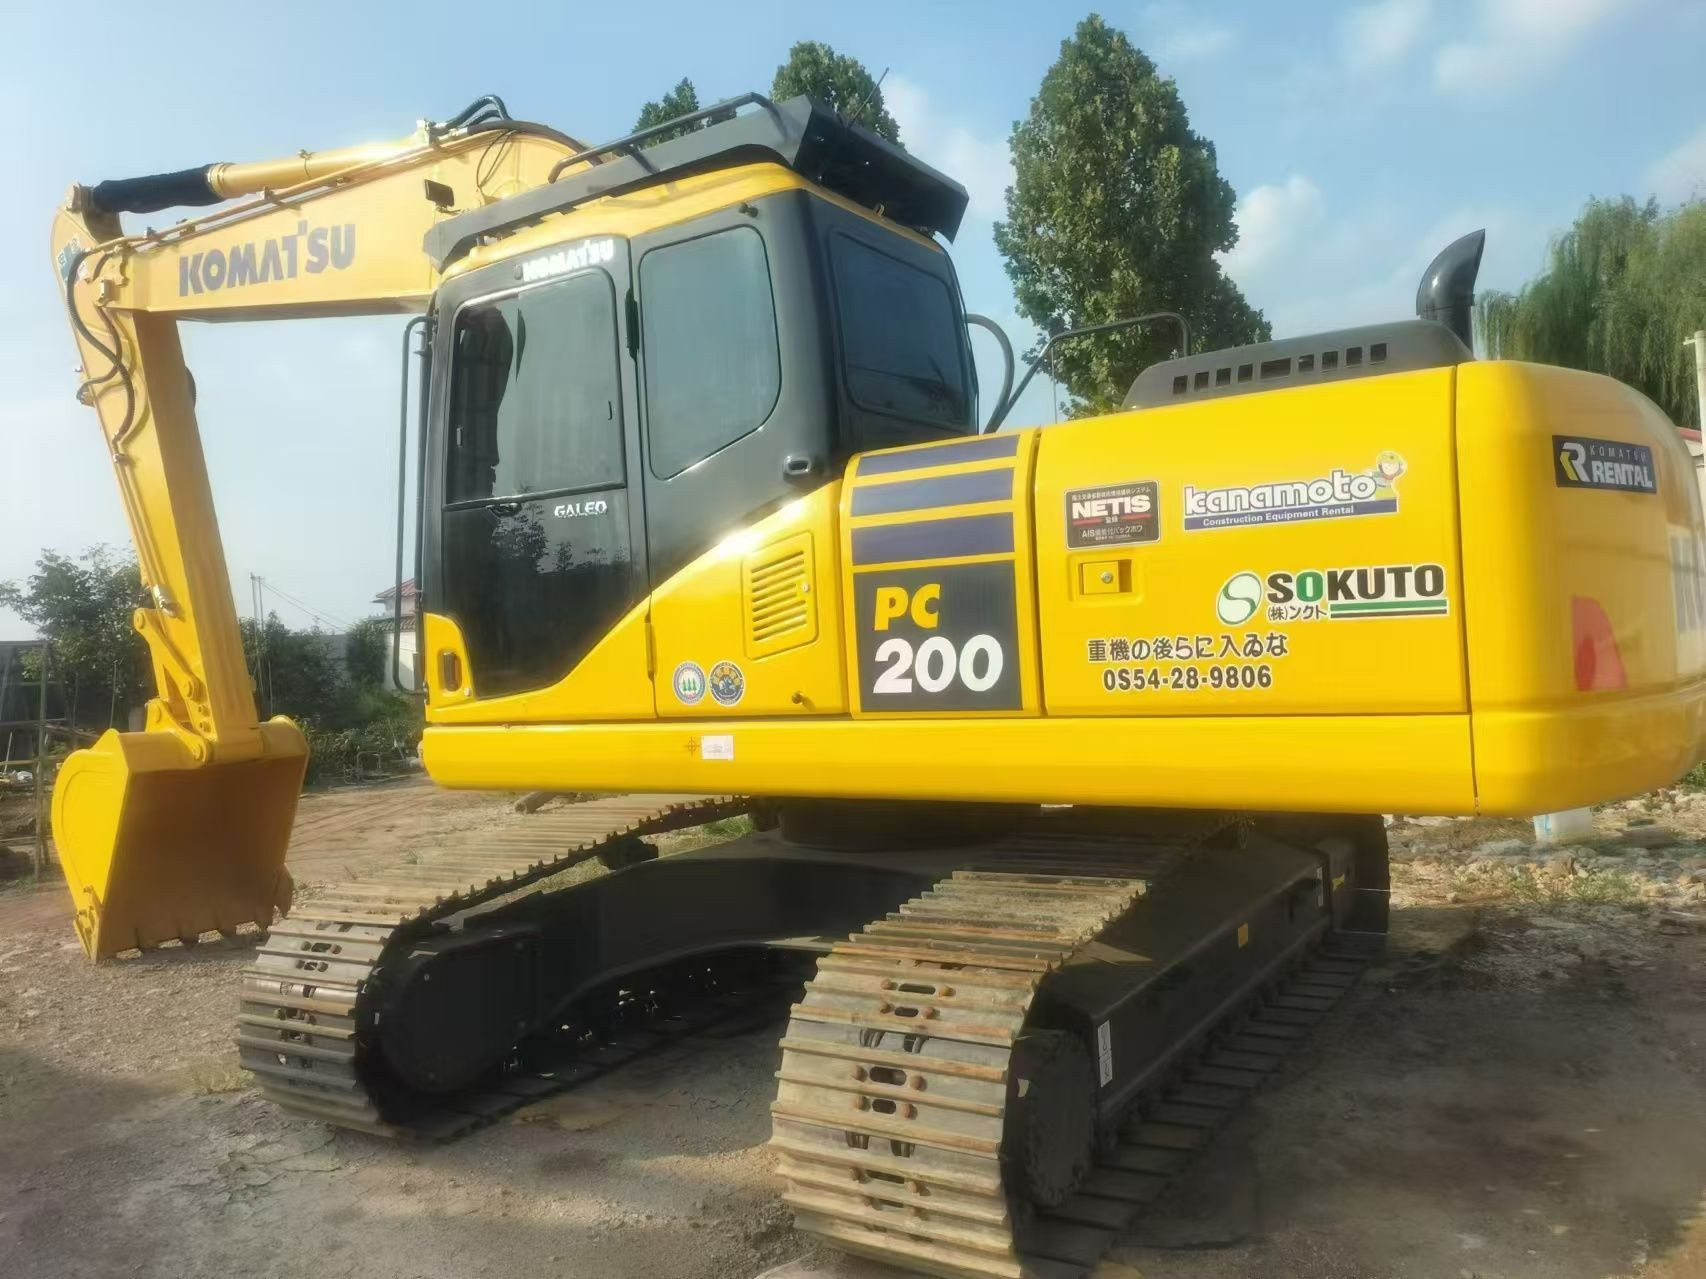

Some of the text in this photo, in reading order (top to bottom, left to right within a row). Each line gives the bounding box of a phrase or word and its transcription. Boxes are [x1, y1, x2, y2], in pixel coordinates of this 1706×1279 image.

[179, 220, 356, 297] KOMATSU
[1184, 470, 1377, 516] kanamoto
[1591, 461, 1653, 488] RENTAL
[554, 501, 608, 518] GALEO
[1072, 494, 1151, 519] NETIS
[1203, 505, 1355, 527] Construction Equipment Rental
[1267, 564, 1444, 604] SOKUTO
[874, 583, 941, 631] PC
[872, 634, 1004, 694] 200
